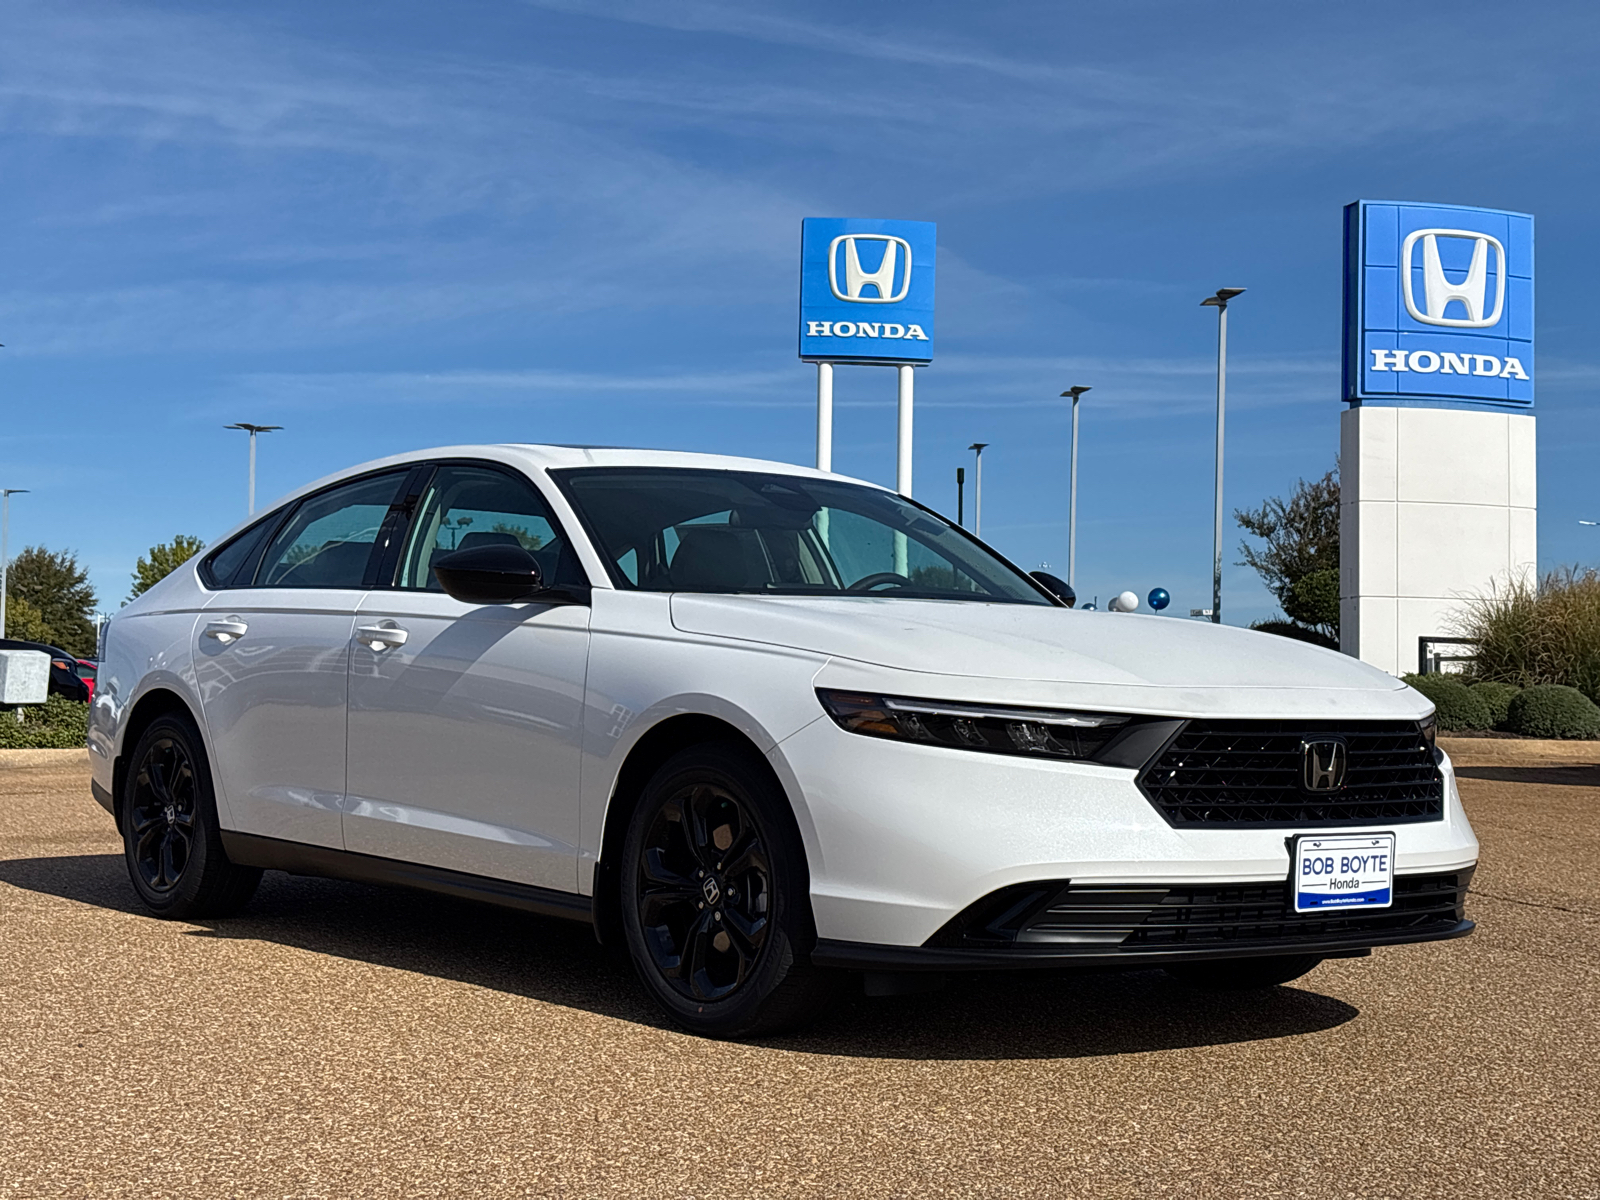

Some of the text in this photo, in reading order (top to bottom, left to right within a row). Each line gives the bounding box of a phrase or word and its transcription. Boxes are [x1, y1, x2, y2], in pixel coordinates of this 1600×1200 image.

[806, 321, 929, 340] HONDA
[1371, 349, 1530, 380] HONDA
[1302, 854, 1388, 875] BOB BOYTE
[1329, 877, 1360, 890] Honda
